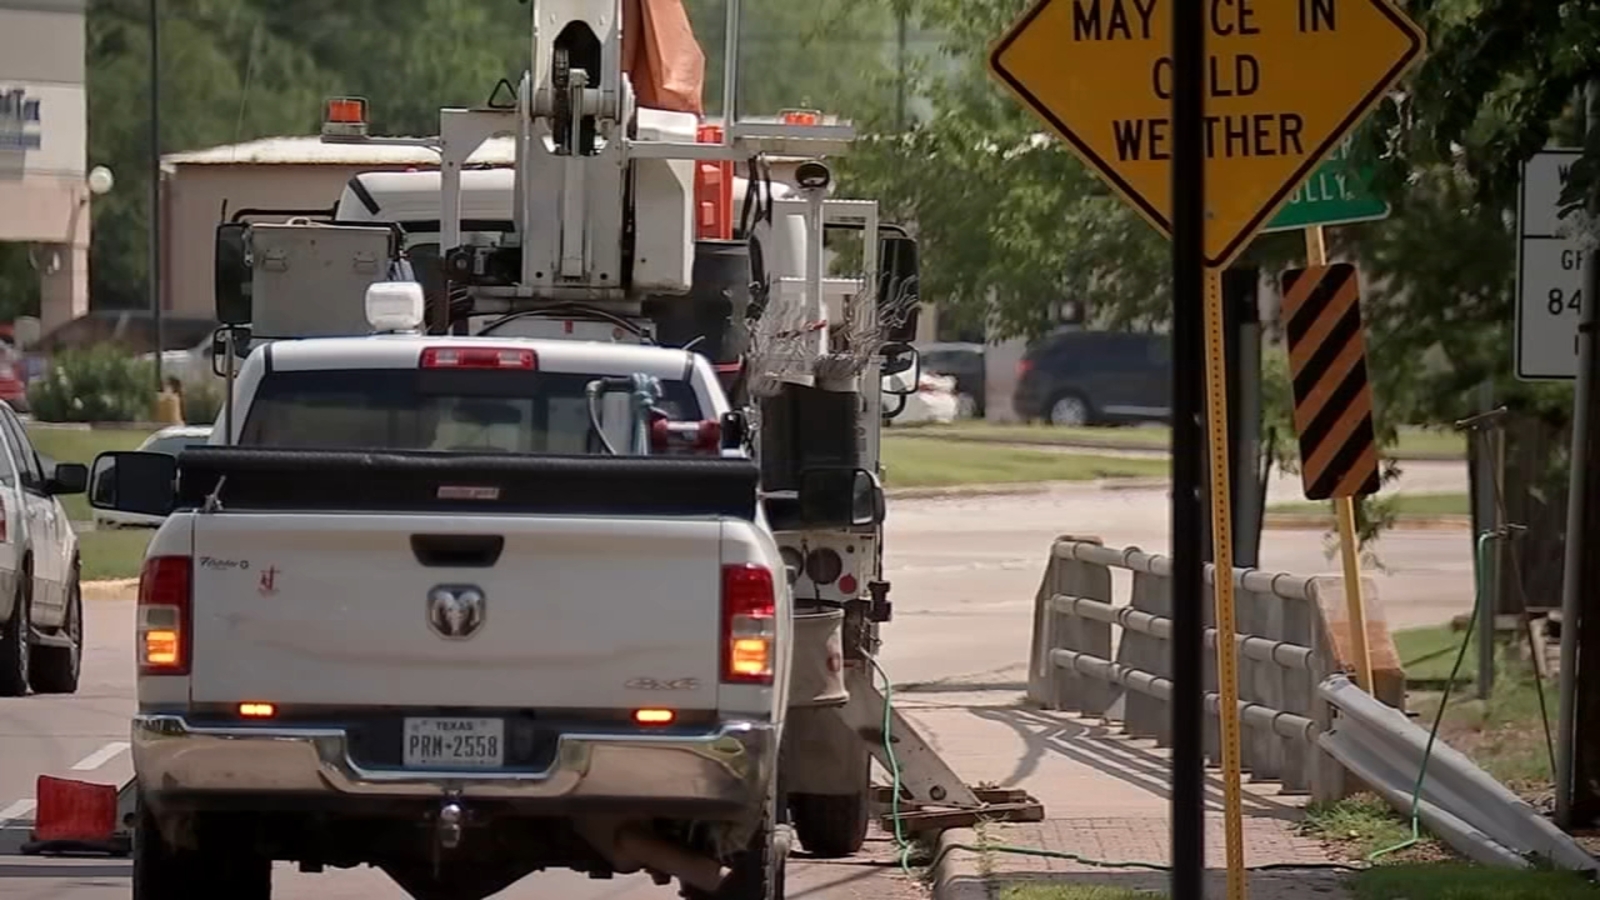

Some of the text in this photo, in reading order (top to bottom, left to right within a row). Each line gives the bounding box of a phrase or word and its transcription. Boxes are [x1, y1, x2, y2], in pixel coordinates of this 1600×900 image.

[1073, 0, 1335, 41] MAY CE IN
[1152, 54, 1260, 99] CLD
[1113, 113, 1304, 161] WETHER
[436, 721, 474, 731] TEXAS
